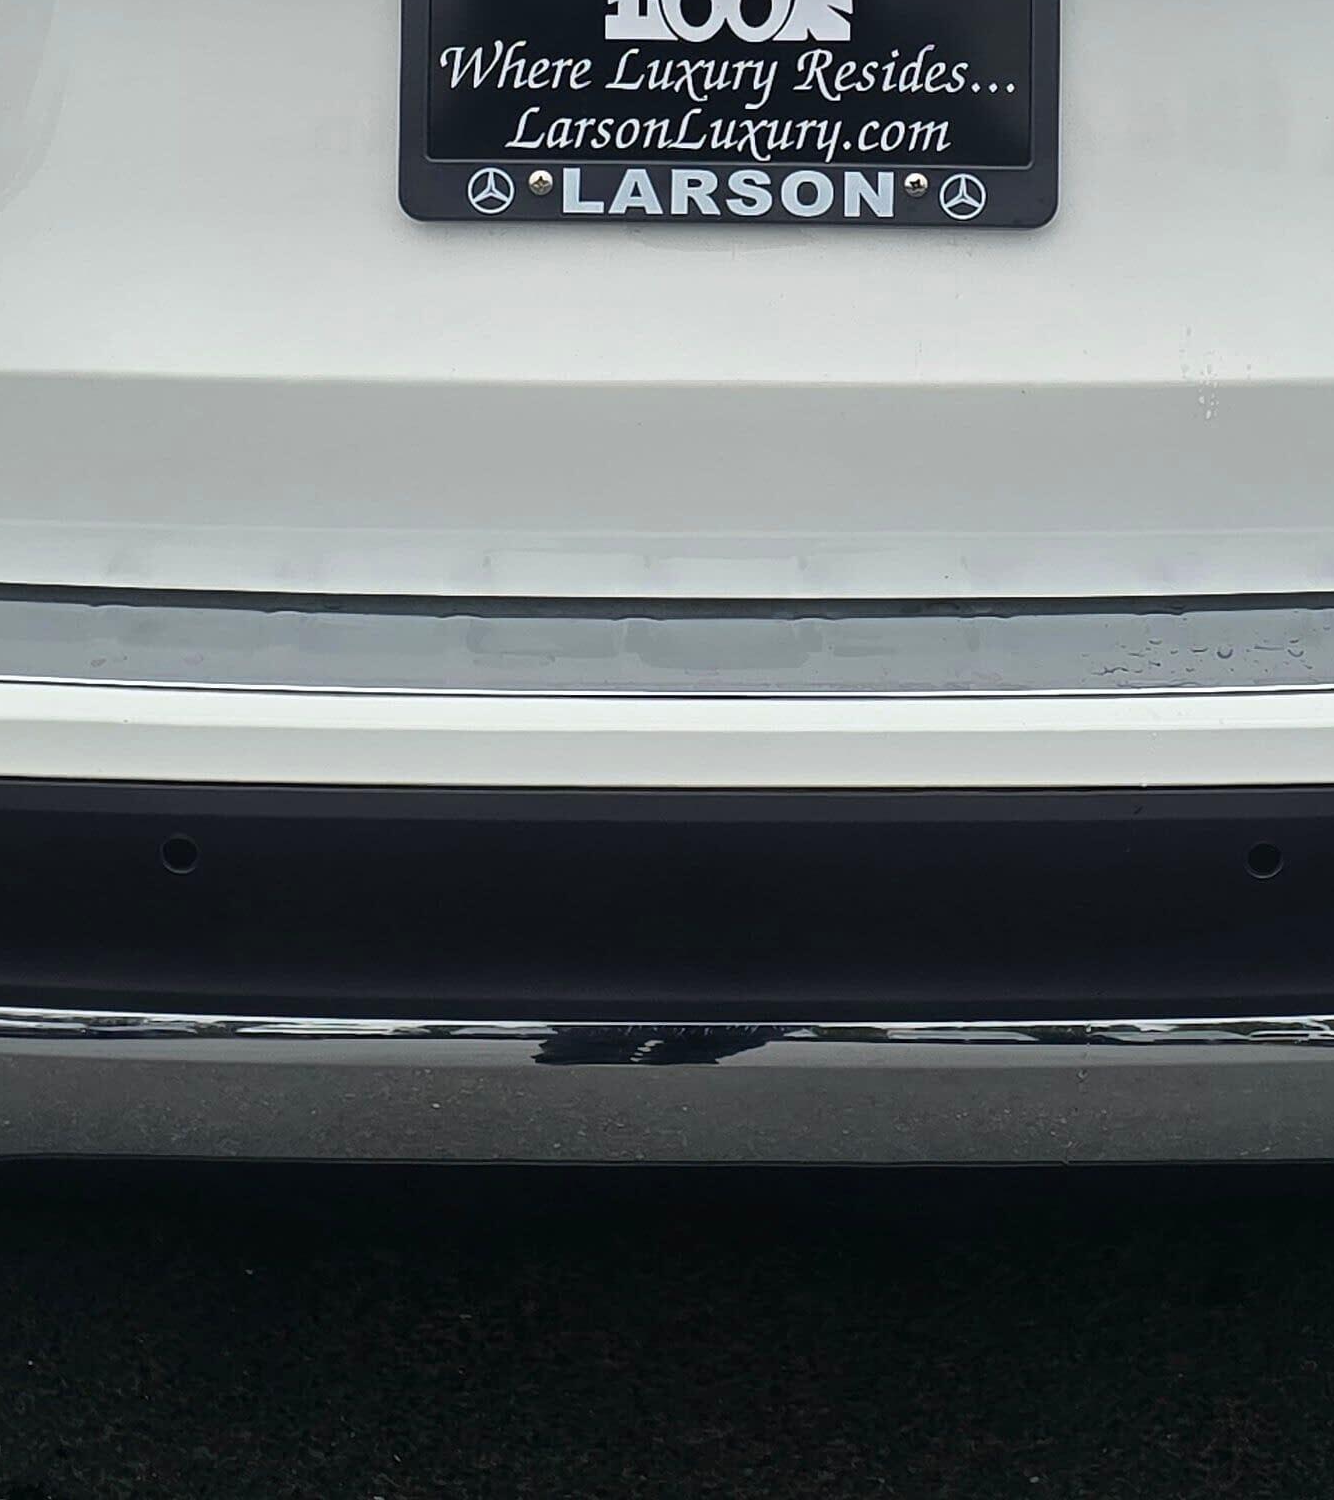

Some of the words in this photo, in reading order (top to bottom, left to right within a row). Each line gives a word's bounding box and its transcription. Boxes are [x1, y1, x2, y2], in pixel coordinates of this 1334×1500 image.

[439, 41, 593, 91] Where
[605, 47, 778, 111] Luxury
[793, 43, 1017, 101] Resides...
[504, 107, 952, 164] LarsonLuxury.com
[561, 167, 897, 219] LARSON
